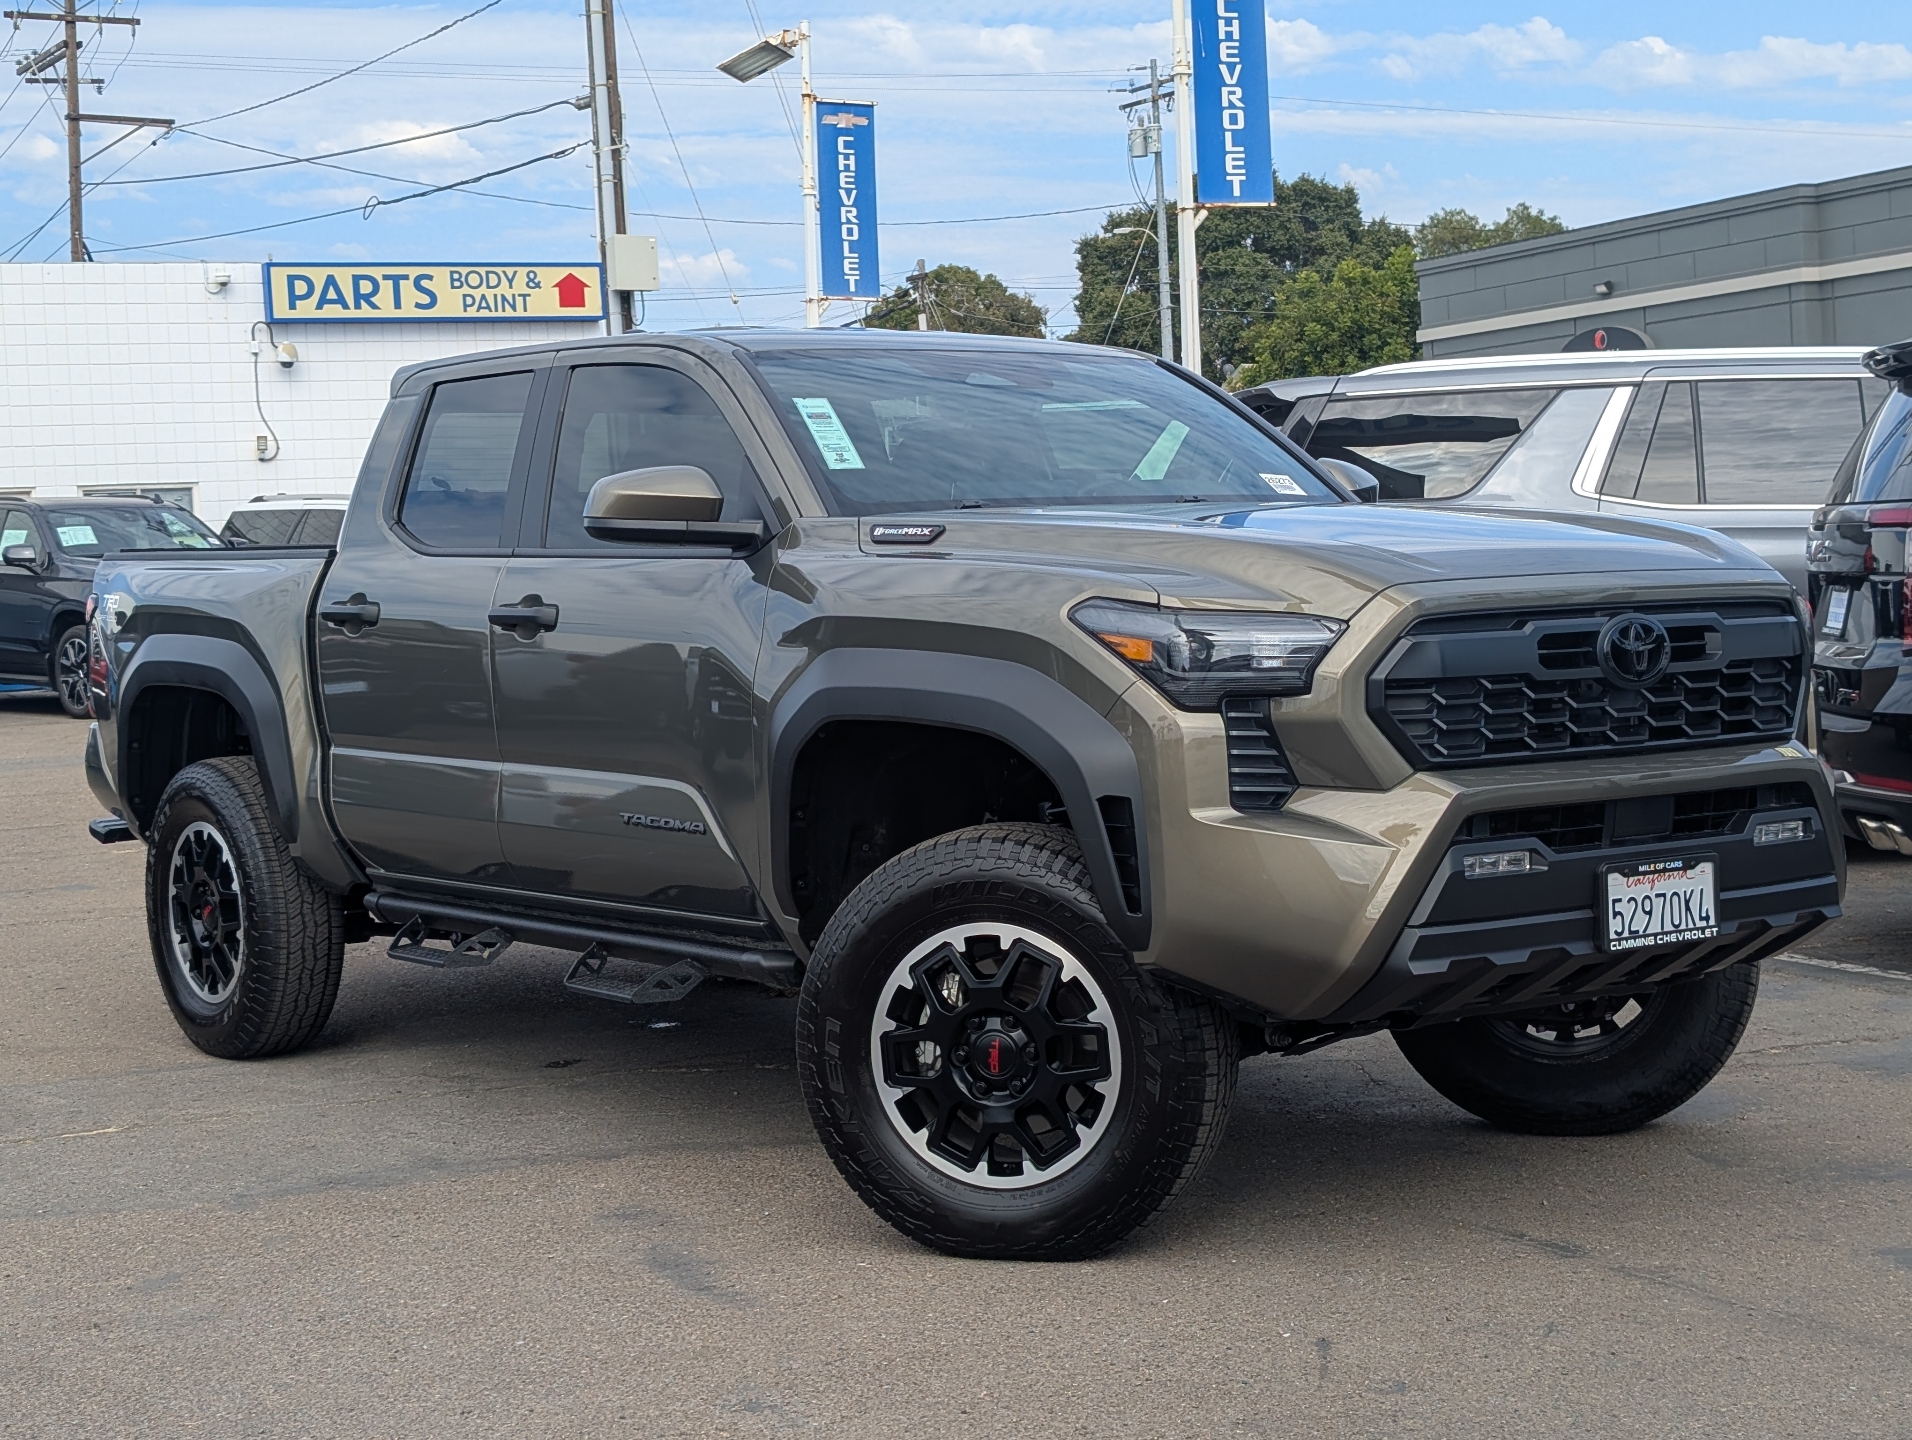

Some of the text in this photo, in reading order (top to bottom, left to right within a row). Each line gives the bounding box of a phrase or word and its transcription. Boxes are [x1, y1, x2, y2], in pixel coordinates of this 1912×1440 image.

[1216, 0, 1246, 197] CHEVROLET
[837, 136, 860, 292] CHEVROLET
[286, 273, 438, 310] PARTS
[449, 270, 542, 290] BODY &
[462, 293, 532, 313] PAINT
[103, 594, 120, 612] TRD
[619, 812, 706, 834] TACOMA
[1638, 861, 1683, 872] MILE OF CARS
[1611, 887, 1711, 937] 52970K4
[1610, 927, 1718, 951] CUMMING CHEVROLET
[988, 1037, 1000, 1073] TRD
